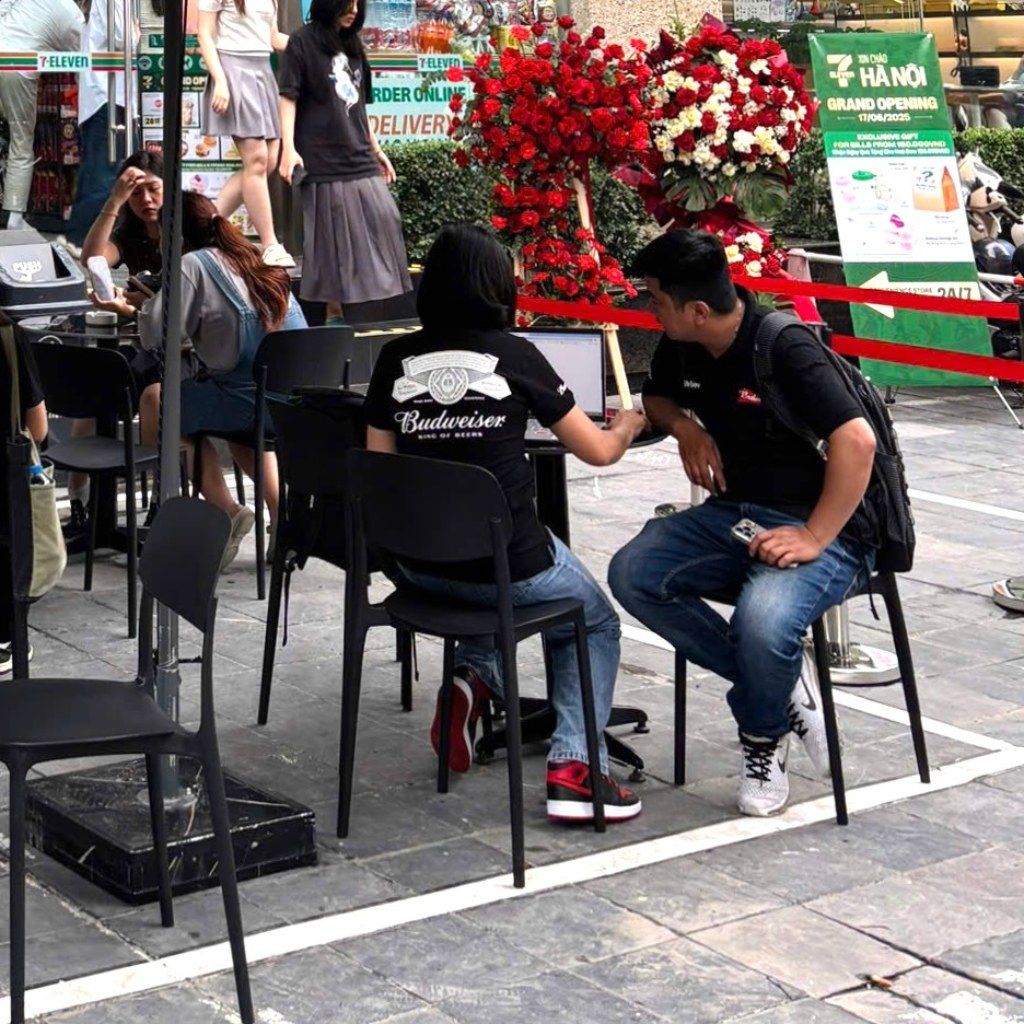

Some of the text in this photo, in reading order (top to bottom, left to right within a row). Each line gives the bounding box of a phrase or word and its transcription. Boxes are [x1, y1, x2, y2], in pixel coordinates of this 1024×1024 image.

[859, 63, 928, 88] HÀ NỘI
[372, 87, 410, 102] RDER
[827, 96, 938, 111] GRAND OPENING
[395, 409, 506, 434] Budweiser
